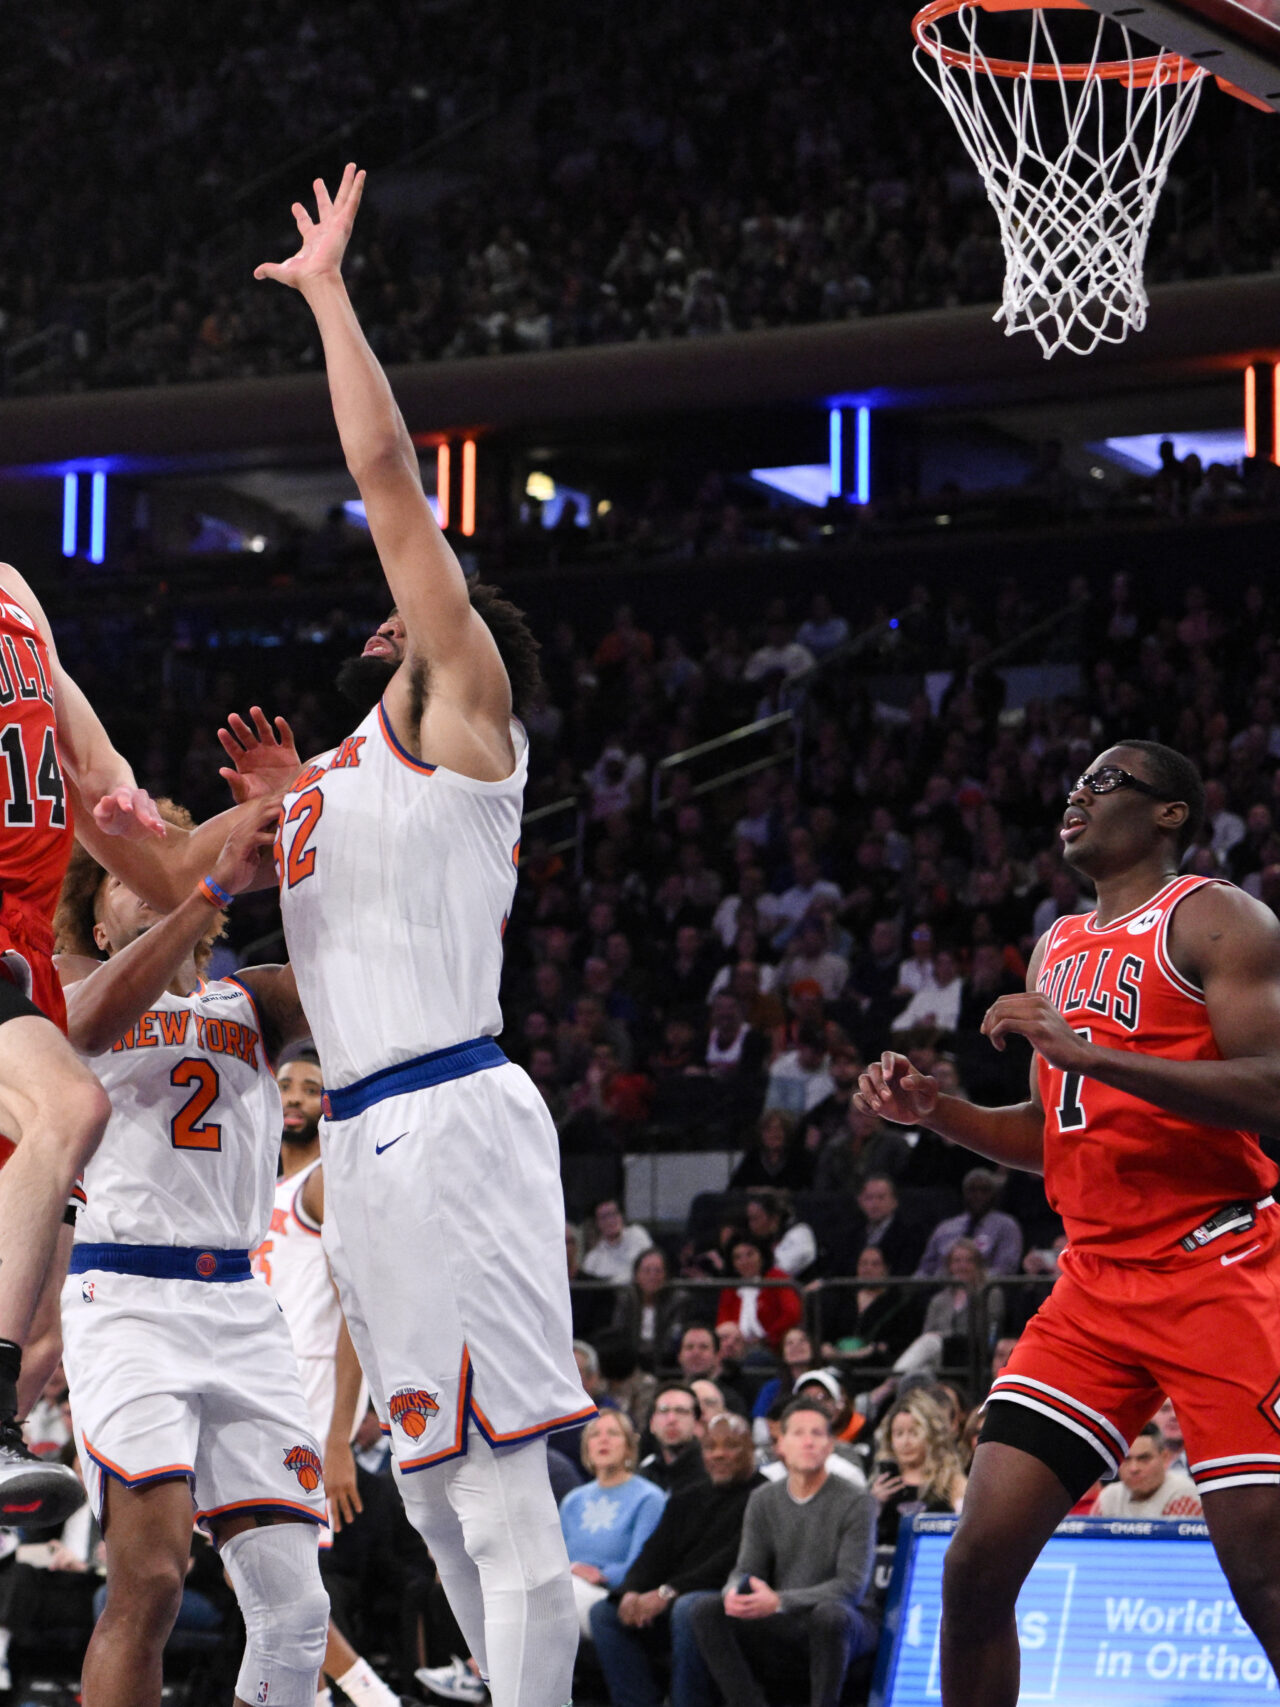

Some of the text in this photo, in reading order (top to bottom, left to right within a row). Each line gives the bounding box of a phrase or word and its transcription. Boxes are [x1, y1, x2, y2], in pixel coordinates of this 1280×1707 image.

[193, 1009, 259, 1071] YORK
[170, 1057, 222, 1152] 2
[390, 1390, 440, 1419] KNICKS
[1110, 1521, 1153, 1535] CHASE
[1177, 1523, 1210, 1536] CHAS
[1104, 1596, 1252, 1637] World's
[1094, 1640, 1133, 1678] in
